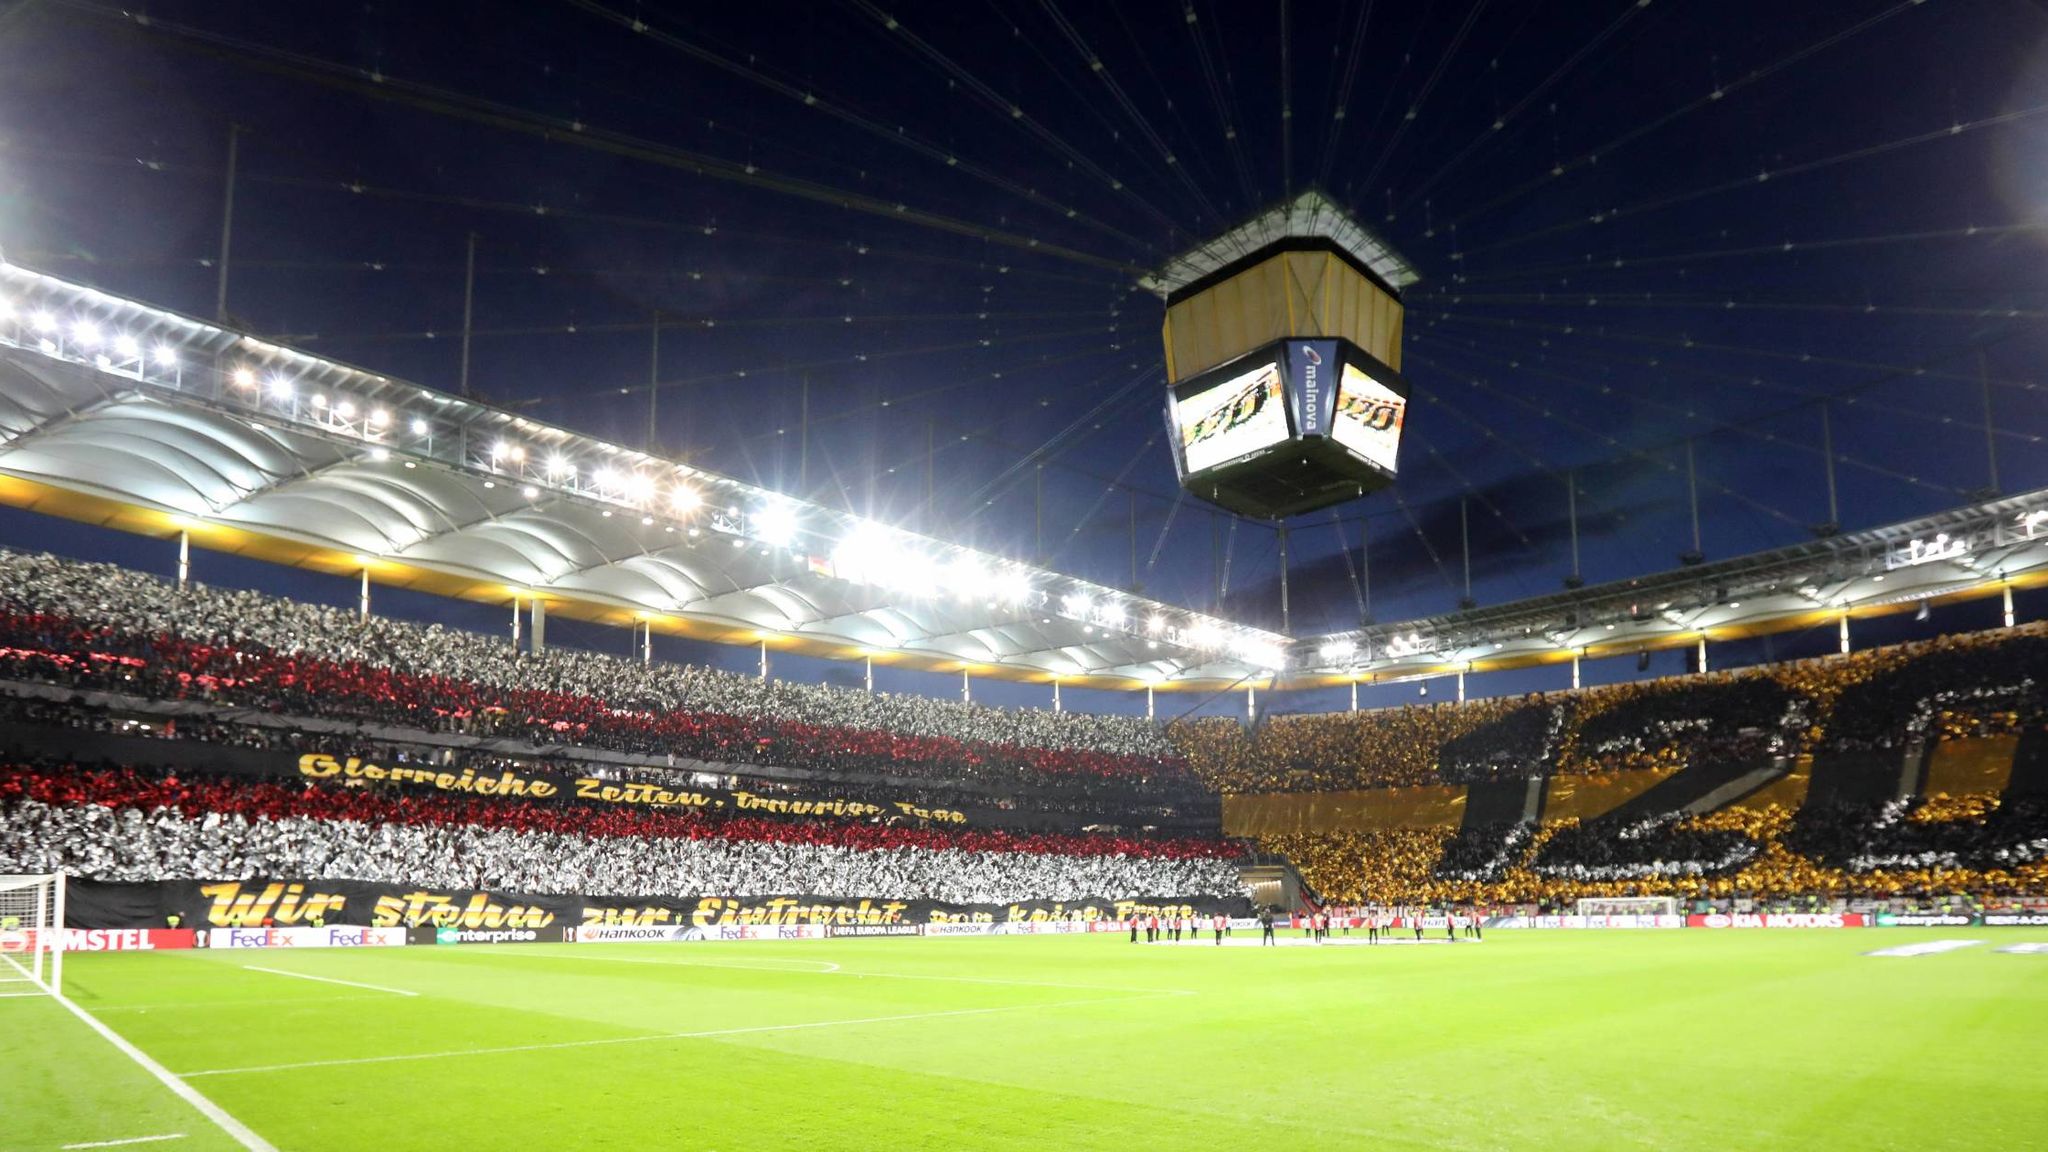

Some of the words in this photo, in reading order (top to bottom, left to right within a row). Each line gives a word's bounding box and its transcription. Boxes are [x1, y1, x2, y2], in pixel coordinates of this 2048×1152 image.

[1304, 364, 1317, 430] mainova
[299, 754, 558, 798] Glorreiche
[200, 882, 346, 928] Wir
[373, 891, 555, 928] stehn
[582, 907, 670, 926] zur
[1732, 914, 1763, 928] KIA
[1766, 914, 1844, 928] MOTORS
[231, 930, 293, 946] FedEx
[330, 929, 387, 945] FedEx
[437, 928, 537, 944] enterprise
[720, 926, 758, 939] FedEx
[779, 925, 814, 939] FedEx
[834, 926, 855, 935] UEFA
[856, 925, 886, 935] EUROPA
[888, 925, 917, 935] LEAGUE
